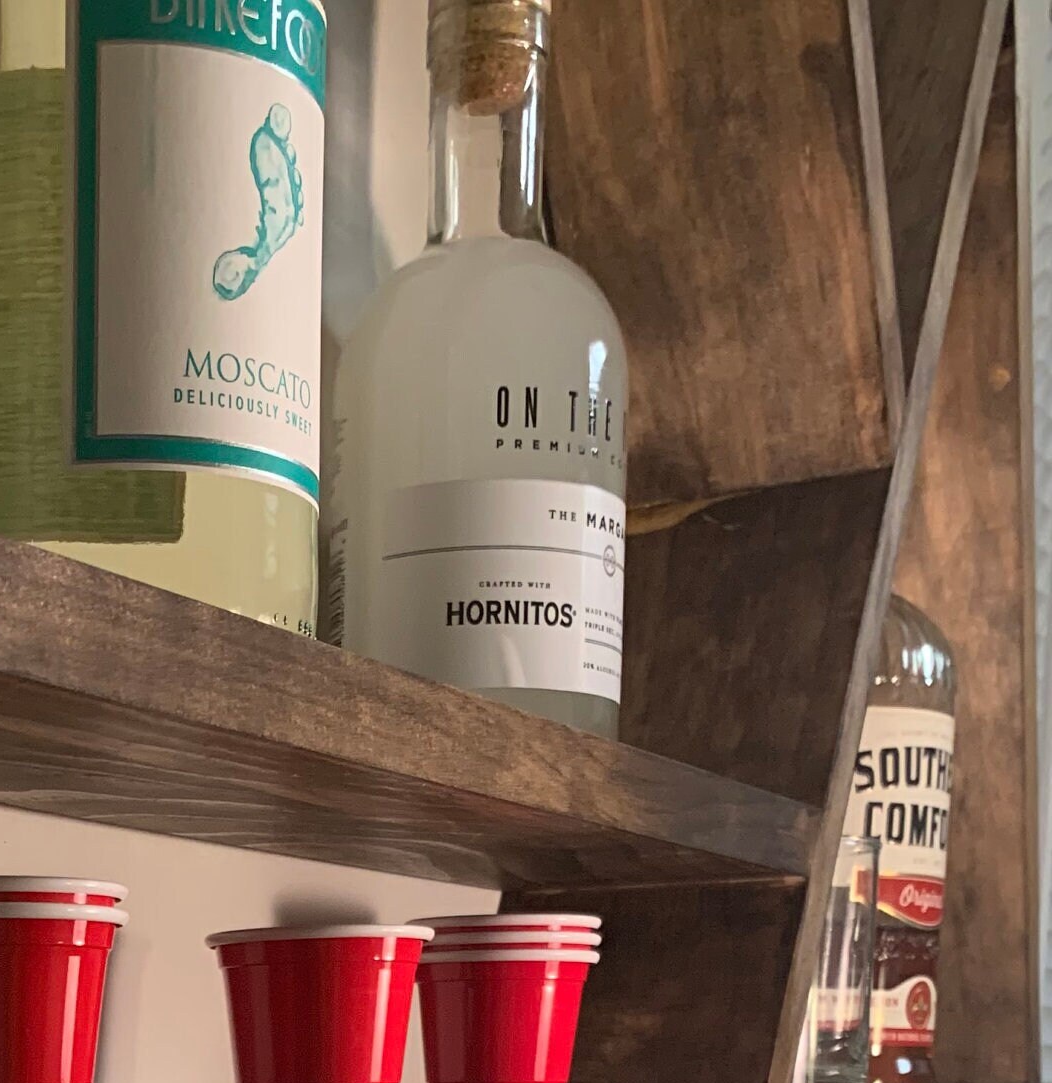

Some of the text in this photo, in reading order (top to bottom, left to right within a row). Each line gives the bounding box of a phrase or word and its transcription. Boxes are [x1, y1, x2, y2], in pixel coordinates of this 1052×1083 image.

[183, 348, 311, 409] MOSCATO
[174, 388, 311, 437] DELICIOUSLY SWEET
[497, 386, 612, 441] ON THE
[548, 509, 577, 522] THE
[479, 581, 551, 590] CRAFTED WITH
